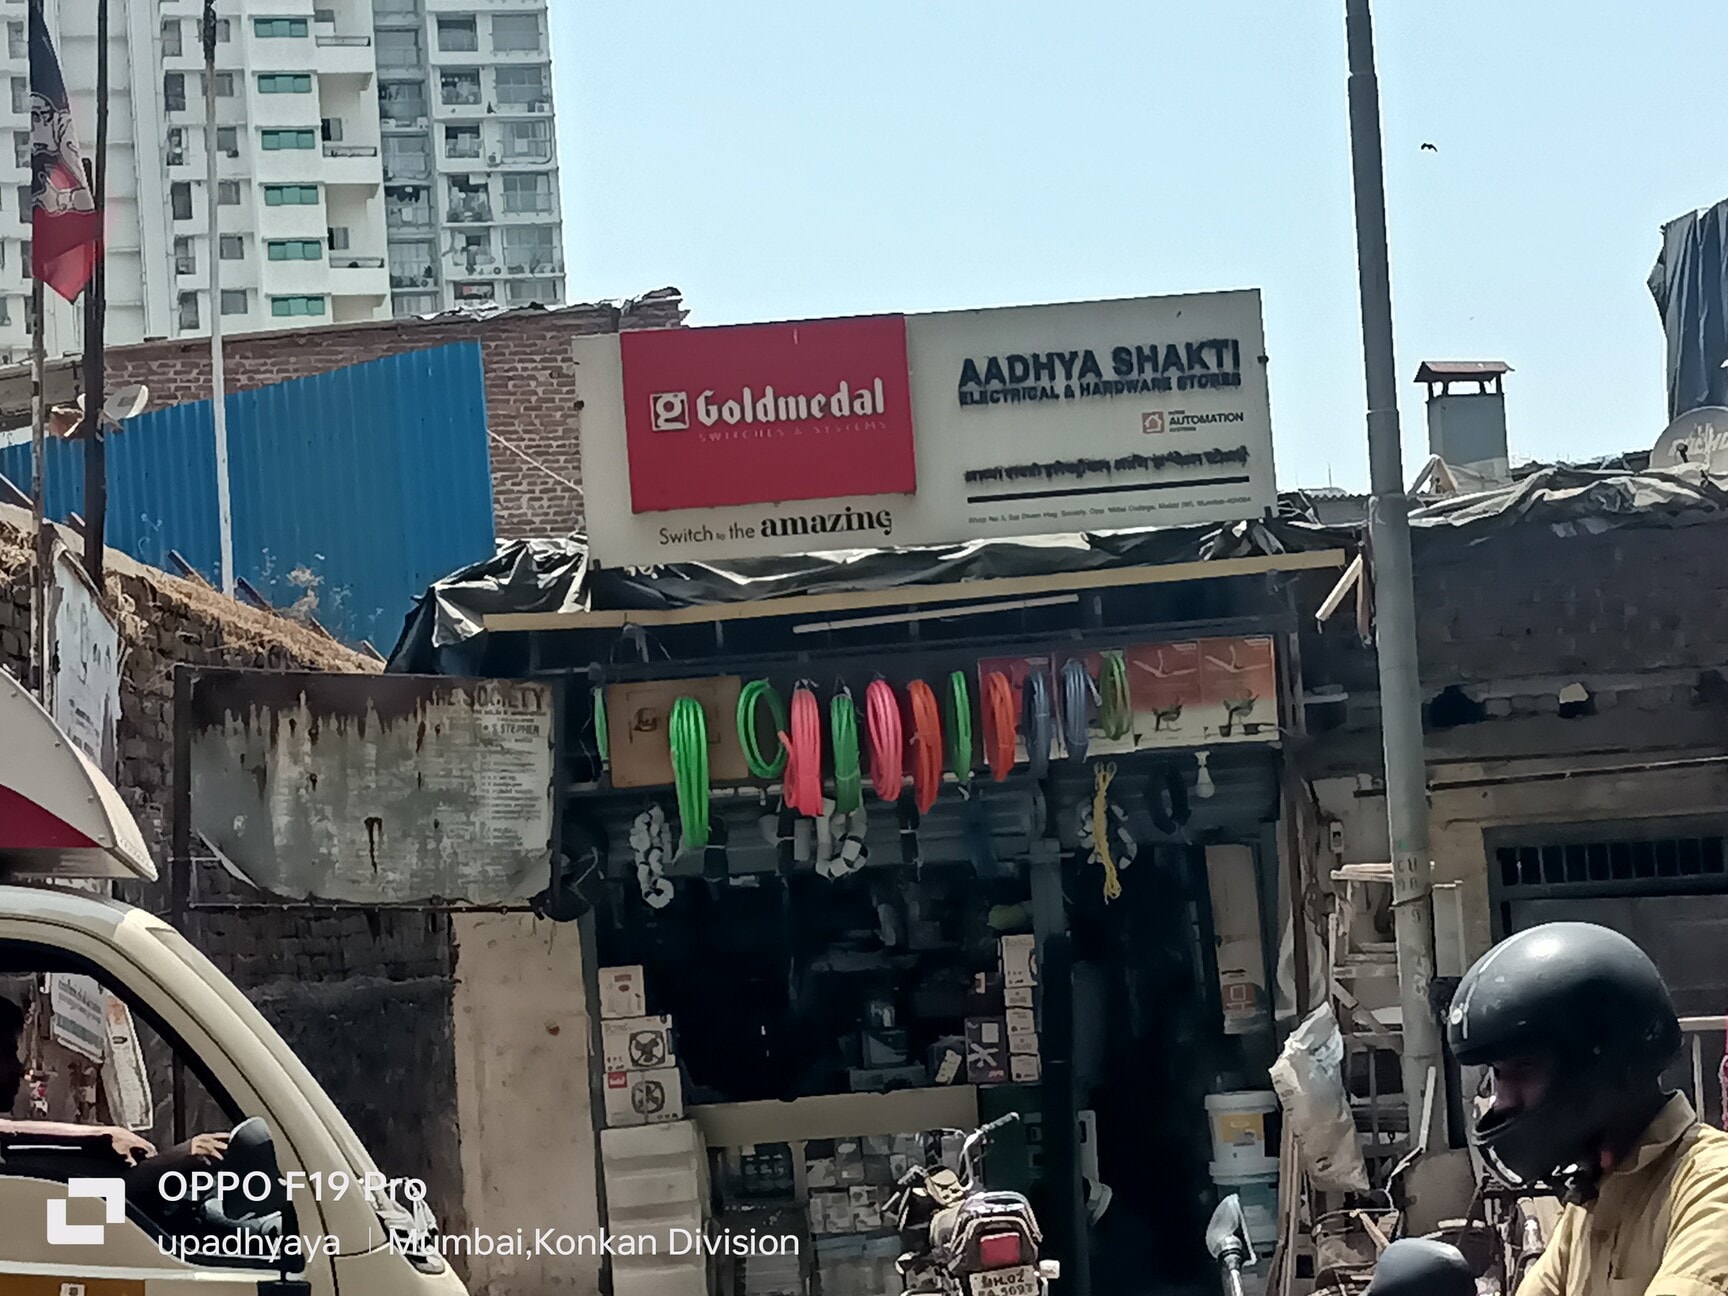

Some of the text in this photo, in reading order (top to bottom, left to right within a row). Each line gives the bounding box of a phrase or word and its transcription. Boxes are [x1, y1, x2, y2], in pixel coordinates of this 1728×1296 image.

[959, 339, 1240, 388] AADHYA SHAKTI
[696, 377, 885, 427] Goldmedal
[959, 372, 1242, 407] ELECTRICAL & HARDWARE STORES
[1169, 412, 1244, 426] AUTOMATION
[659, 525, 714, 545] Switch
[729, 522, 755, 540] the
[760, 506, 892, 538] amazing
